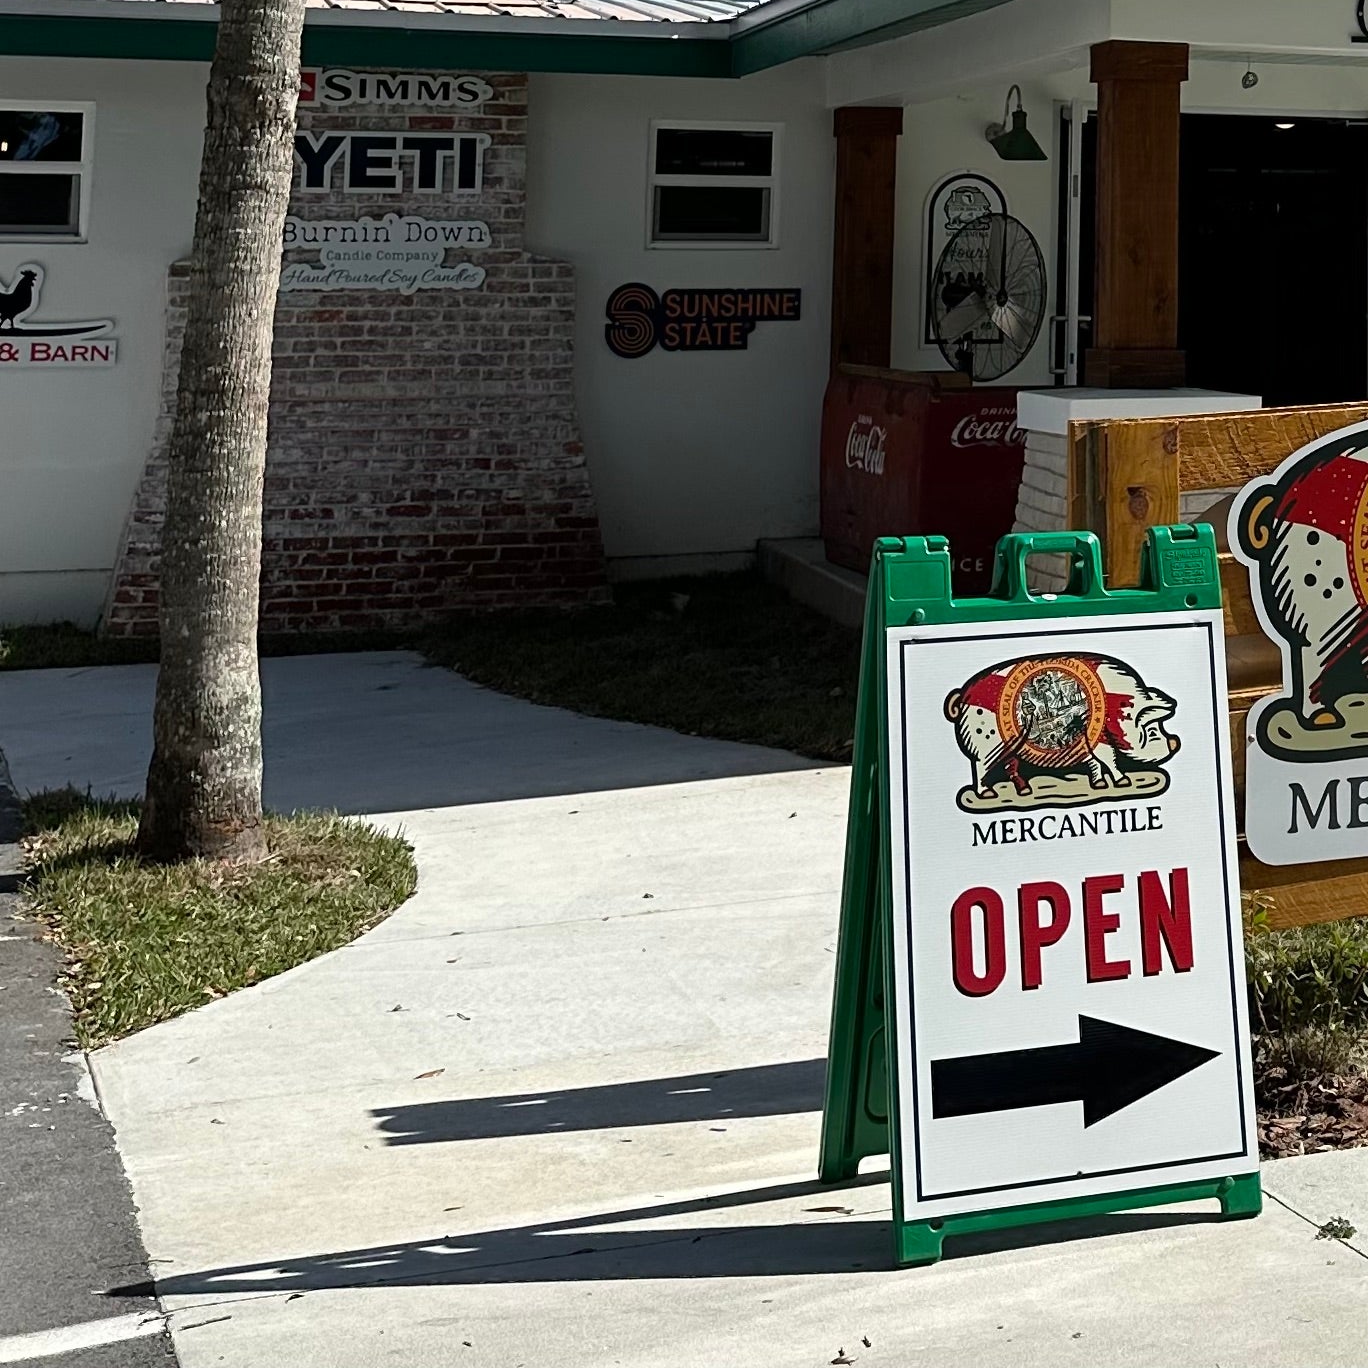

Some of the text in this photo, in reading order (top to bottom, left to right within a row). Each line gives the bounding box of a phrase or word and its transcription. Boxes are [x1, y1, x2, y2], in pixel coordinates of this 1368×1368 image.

[324, 74, 479, 102] SIMMS
[294, 136, 478, 189] YETI
[283, 220, 485, 243] Burnin' Down
[326, 249, 439, 263] Candle Company
[285, 267, 478, 288] Hand Poured Soy Candles
[665, 293, 796, 318] SUNSHINE
[664, 323, 743, 346] STATE
[0, 343, 109, 362] & BARN
[1009, 677, 1020, 690] OF
[971, 806, 1163, 846] MERCANTILE
[949, 867, 1196, 998] OPEN
